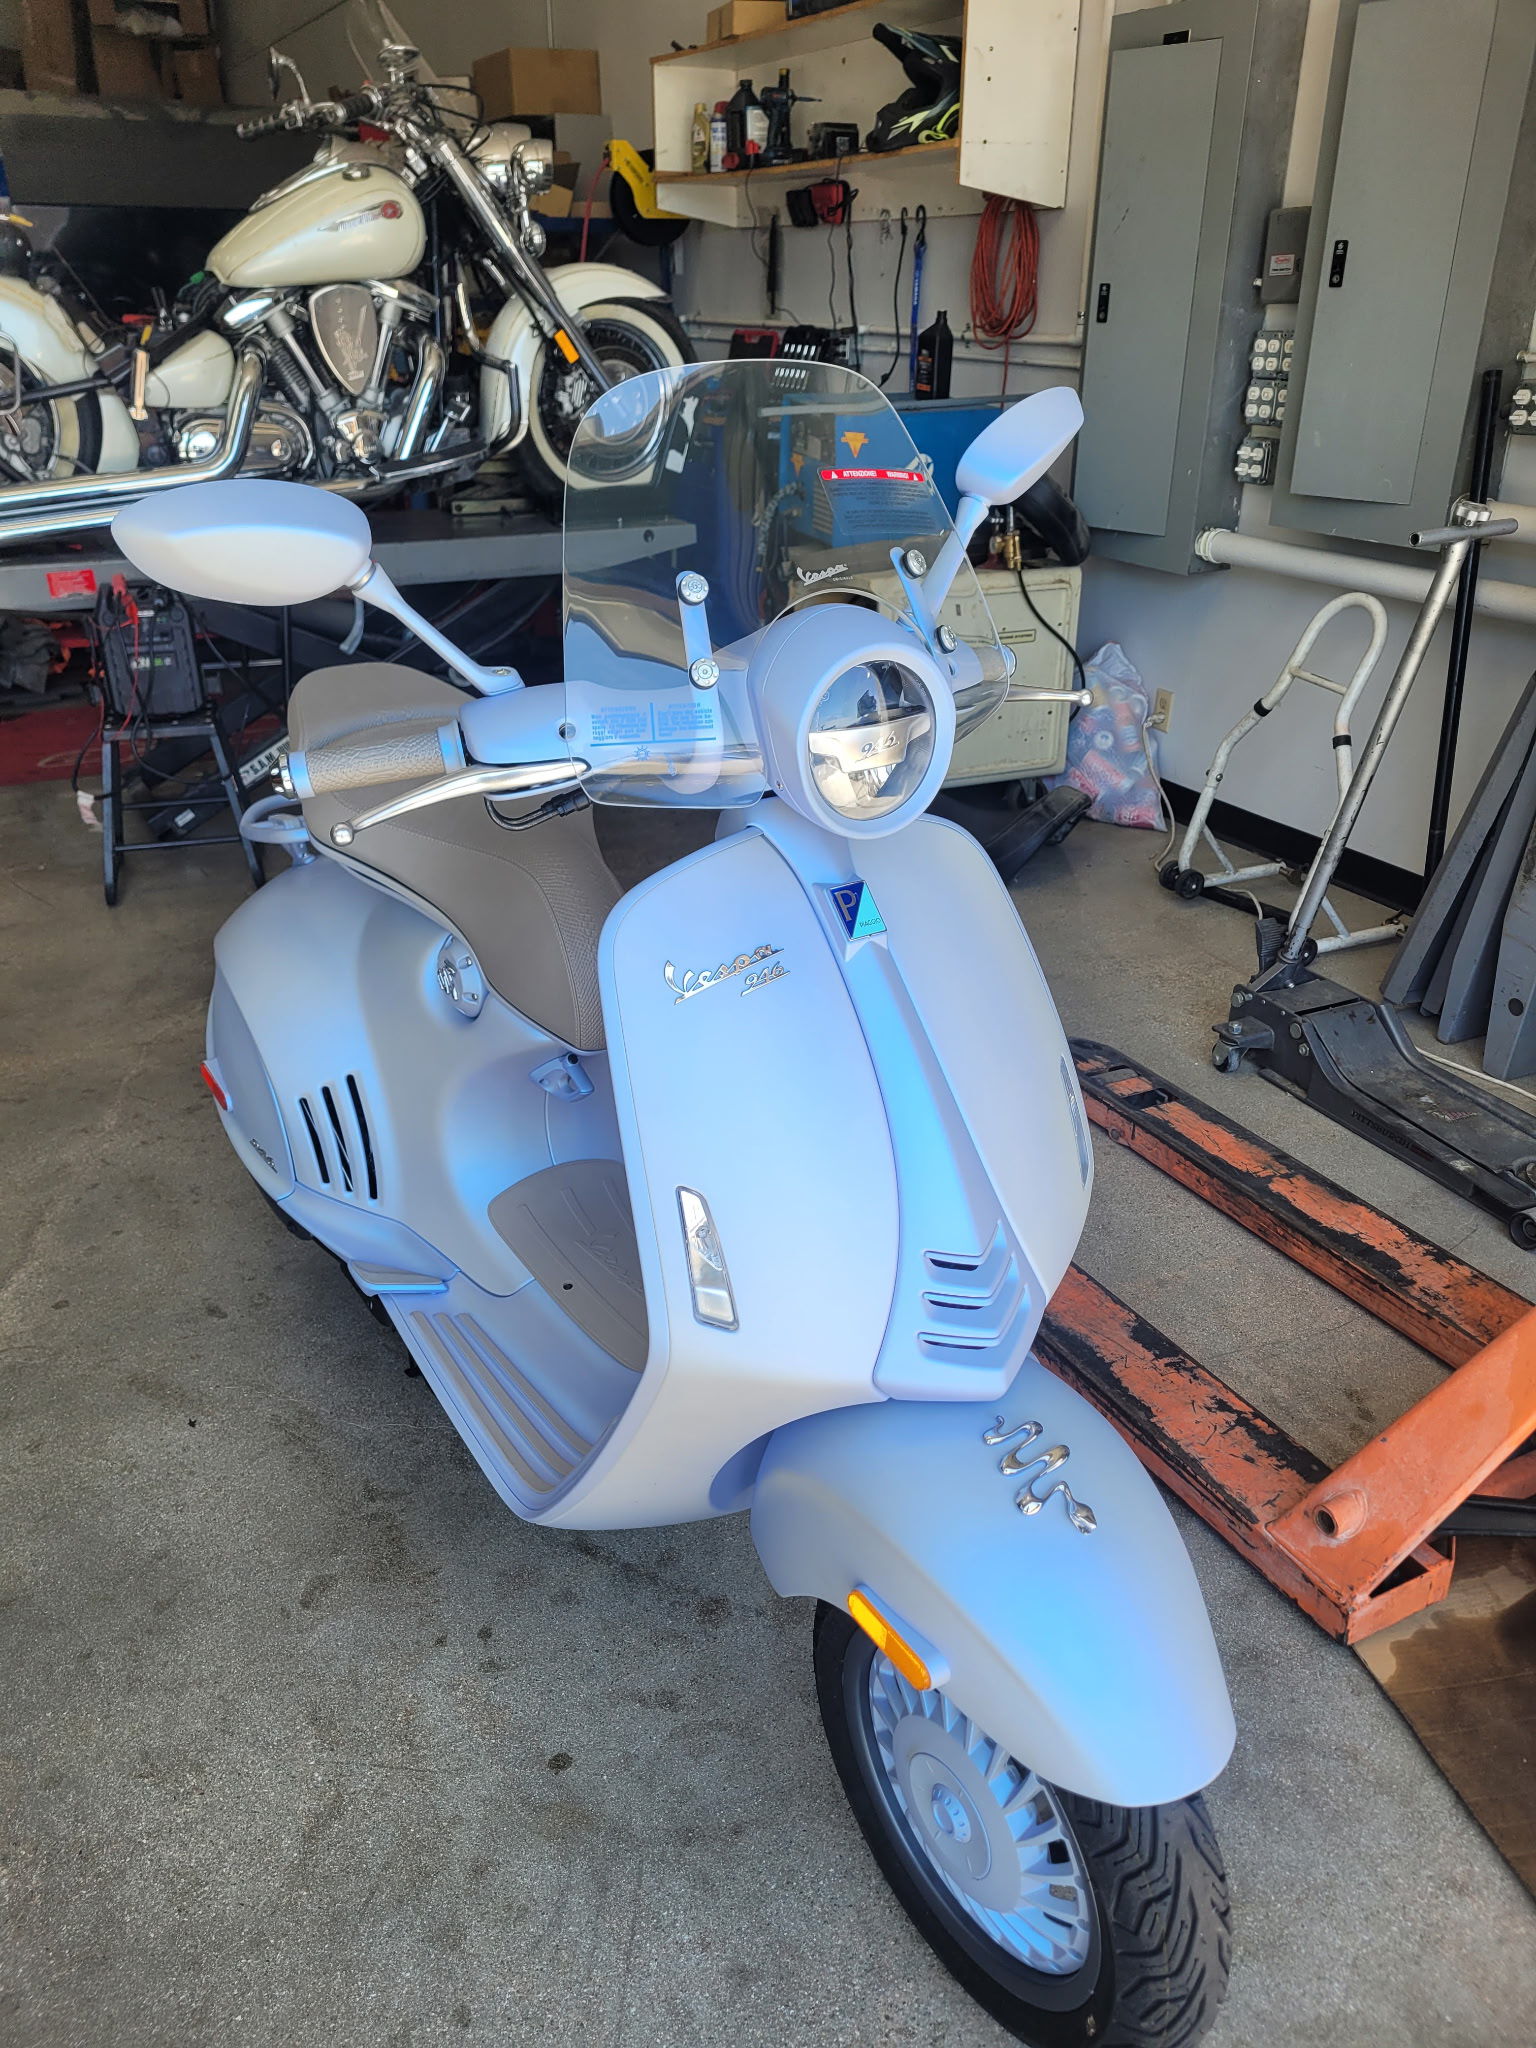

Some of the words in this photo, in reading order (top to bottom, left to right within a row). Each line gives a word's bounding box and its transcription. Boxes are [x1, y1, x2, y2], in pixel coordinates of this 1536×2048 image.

[796, 563, 849, 587] Vespa
[855, 730, 900, 763] 946
[833, 889, 857, 921] P
[663, 943, 785, 1006] Vespa
[740, 960, 790, 997] 946
